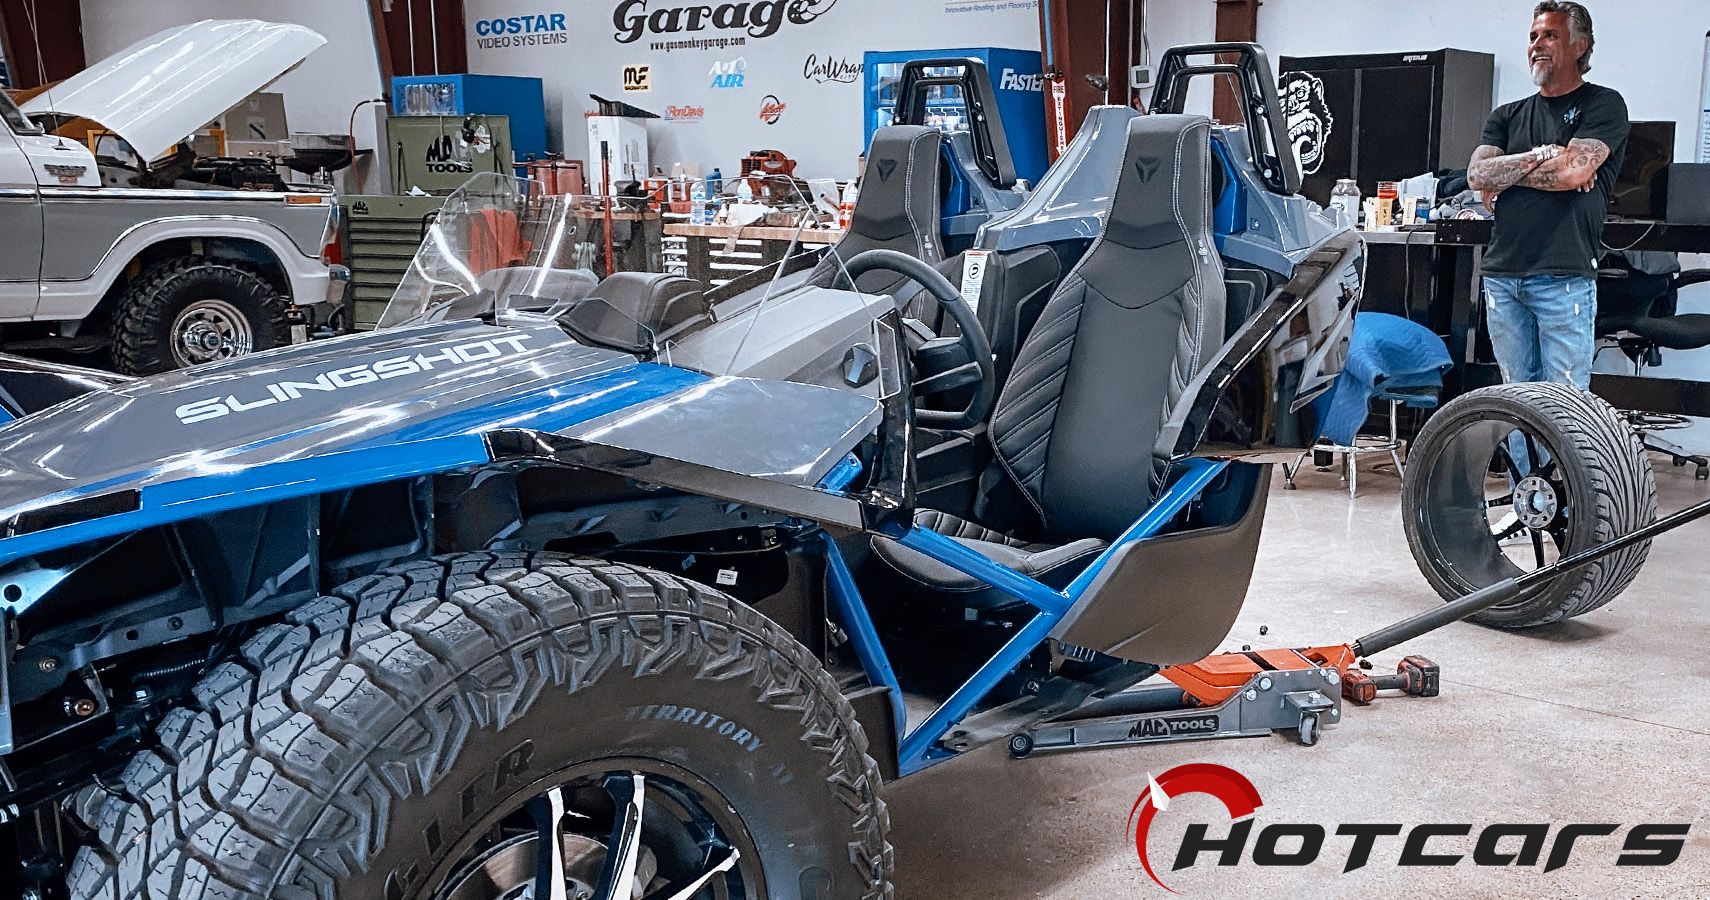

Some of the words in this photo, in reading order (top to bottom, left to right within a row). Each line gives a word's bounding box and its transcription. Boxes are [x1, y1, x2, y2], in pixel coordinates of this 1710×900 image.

[974, 4, 995, 12] Roofing
[996, 2, 1008, 10] and
[1008, 1, 1031, 9] Flooring
[476, 13, 567, 36] COSTAR
[613, 0, 838, 43] Garage
[477, 36, 510, 49] VIDEO
[513, 32, 567, 47] SYSTEMS
[650, 37, 746, 52] www.gasmonkeygarage.com
[175, 334, 533, 424] SLINGSHOT
[1170, 719, 1217, 732] TOOLS
